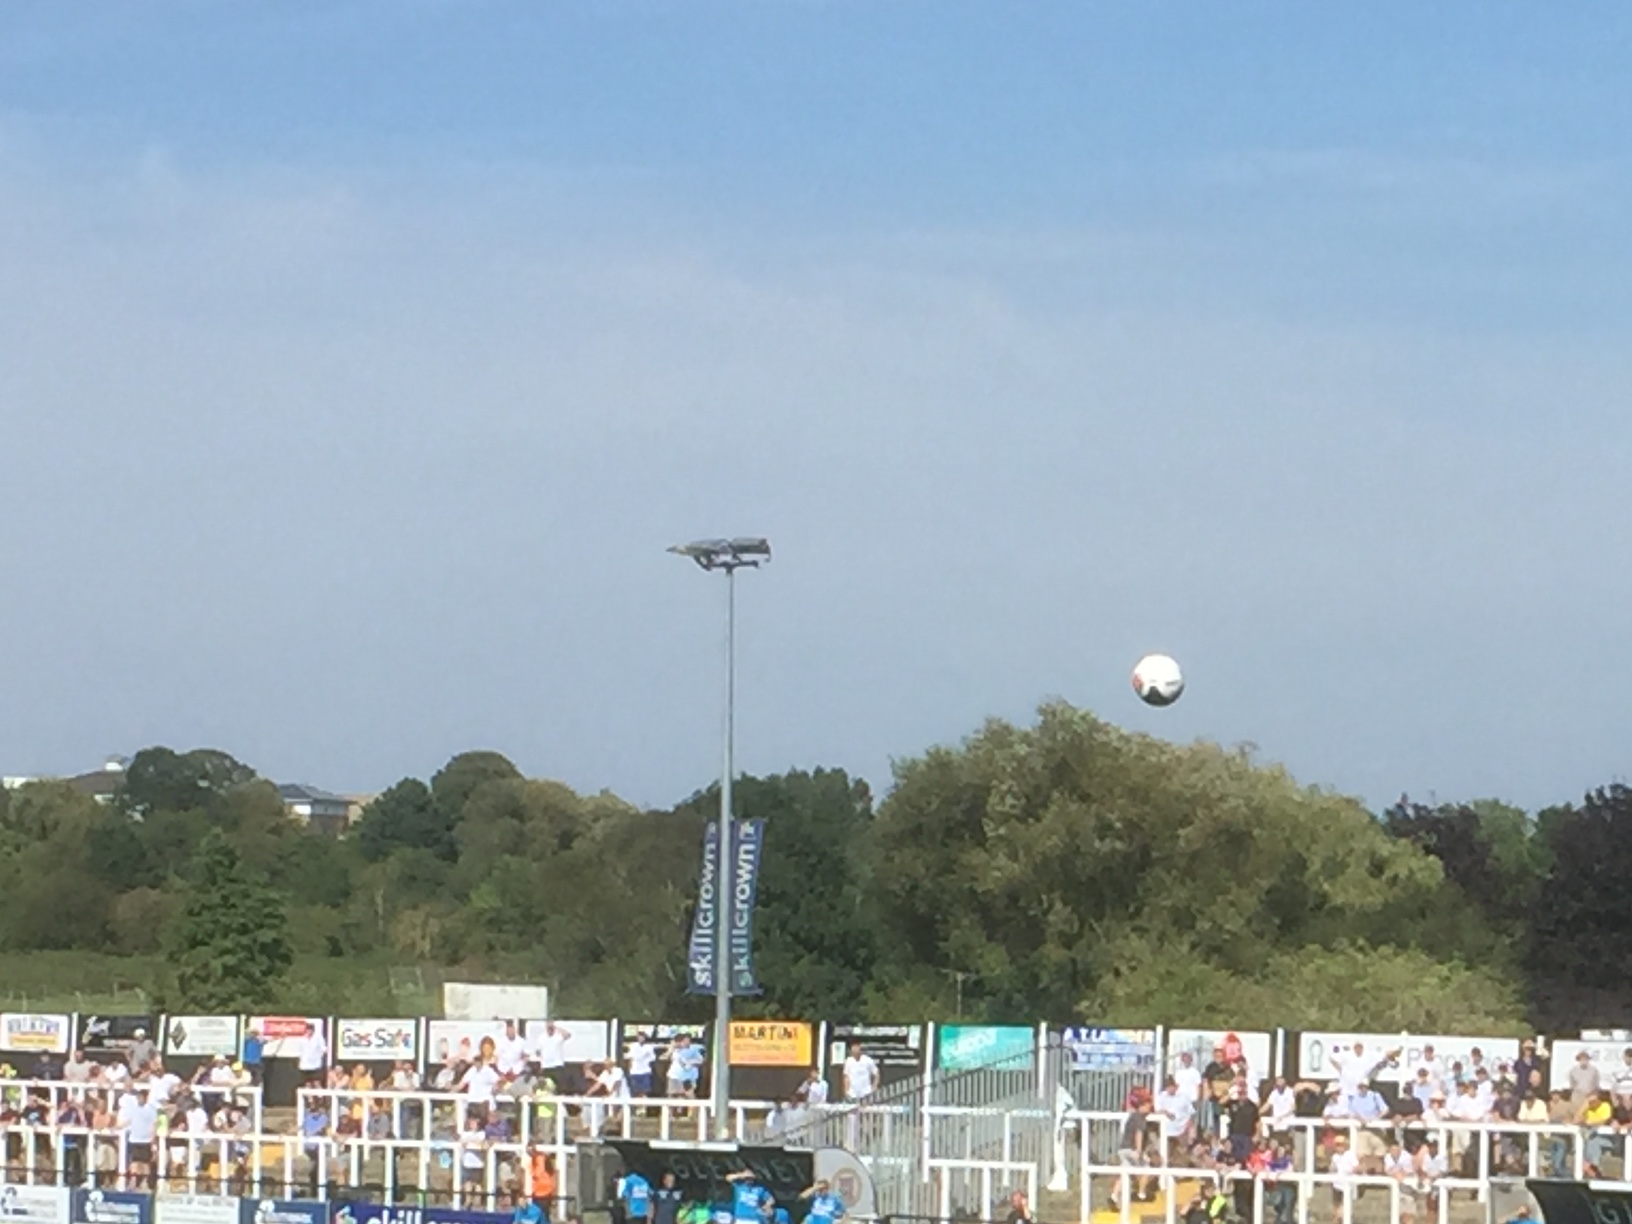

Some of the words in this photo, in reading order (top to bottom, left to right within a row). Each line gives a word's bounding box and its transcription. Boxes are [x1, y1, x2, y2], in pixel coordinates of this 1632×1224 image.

[690, 844, 716, 987] skillcrown
[732, 844, 756, 987] skillcrown
[341, 1029, 371, 1048] Gas
